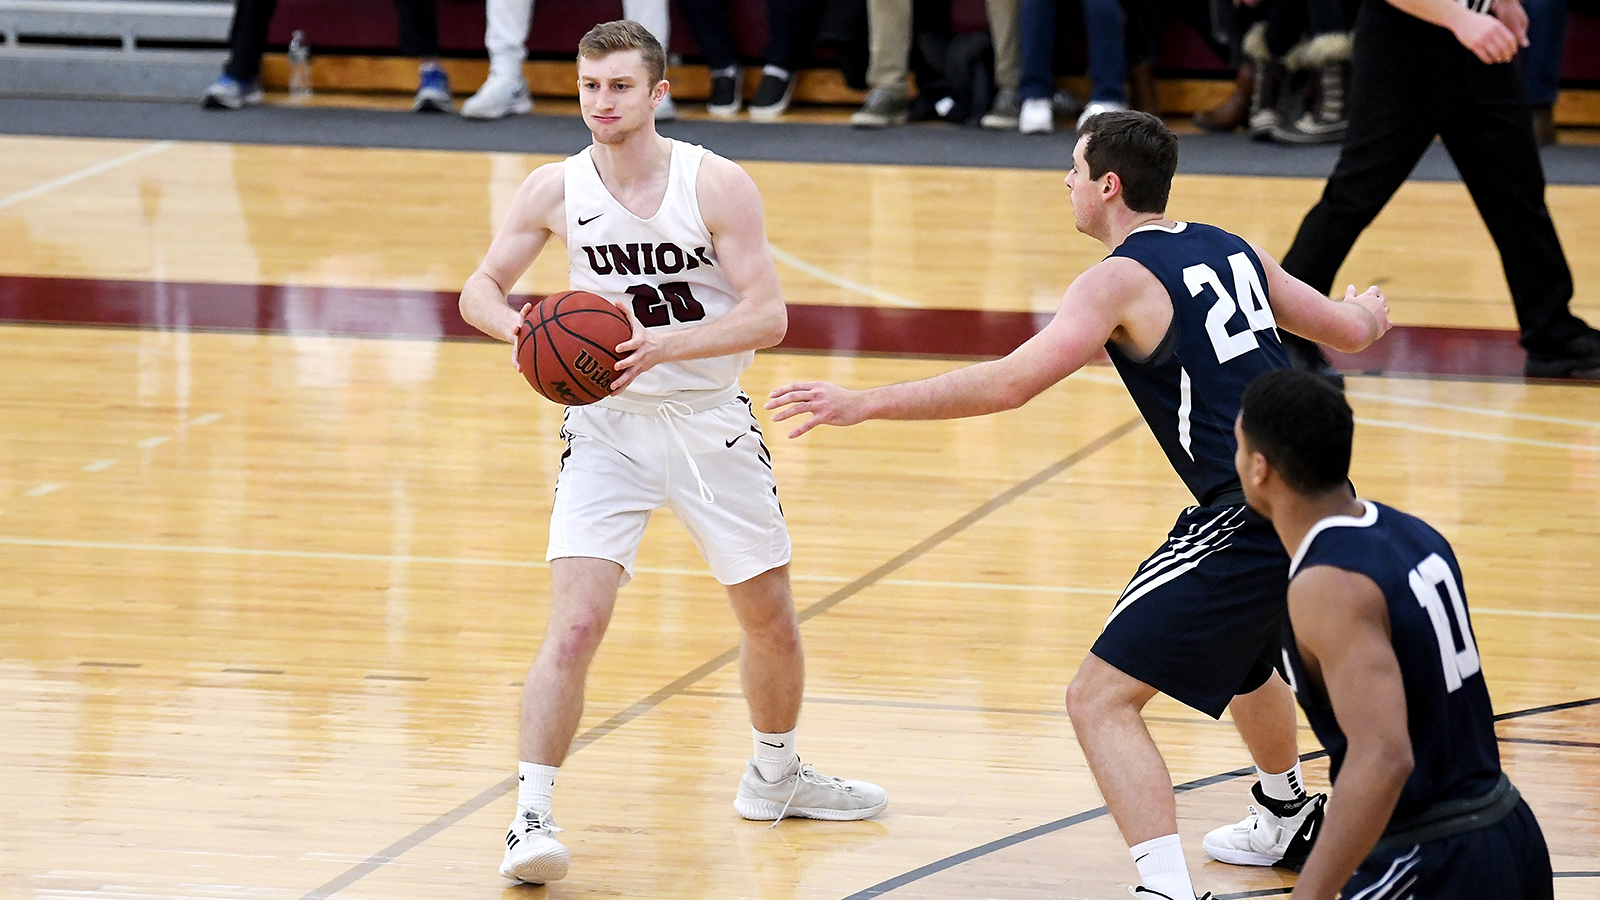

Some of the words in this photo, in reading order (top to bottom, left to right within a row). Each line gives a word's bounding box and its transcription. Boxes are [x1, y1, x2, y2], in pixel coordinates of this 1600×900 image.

[624, 281, 707, 329] 20
[1182, 251, 1282, 365] 24
[573, 348, 612, 392] Wils
[1408, 552, 1480, 694] 10
